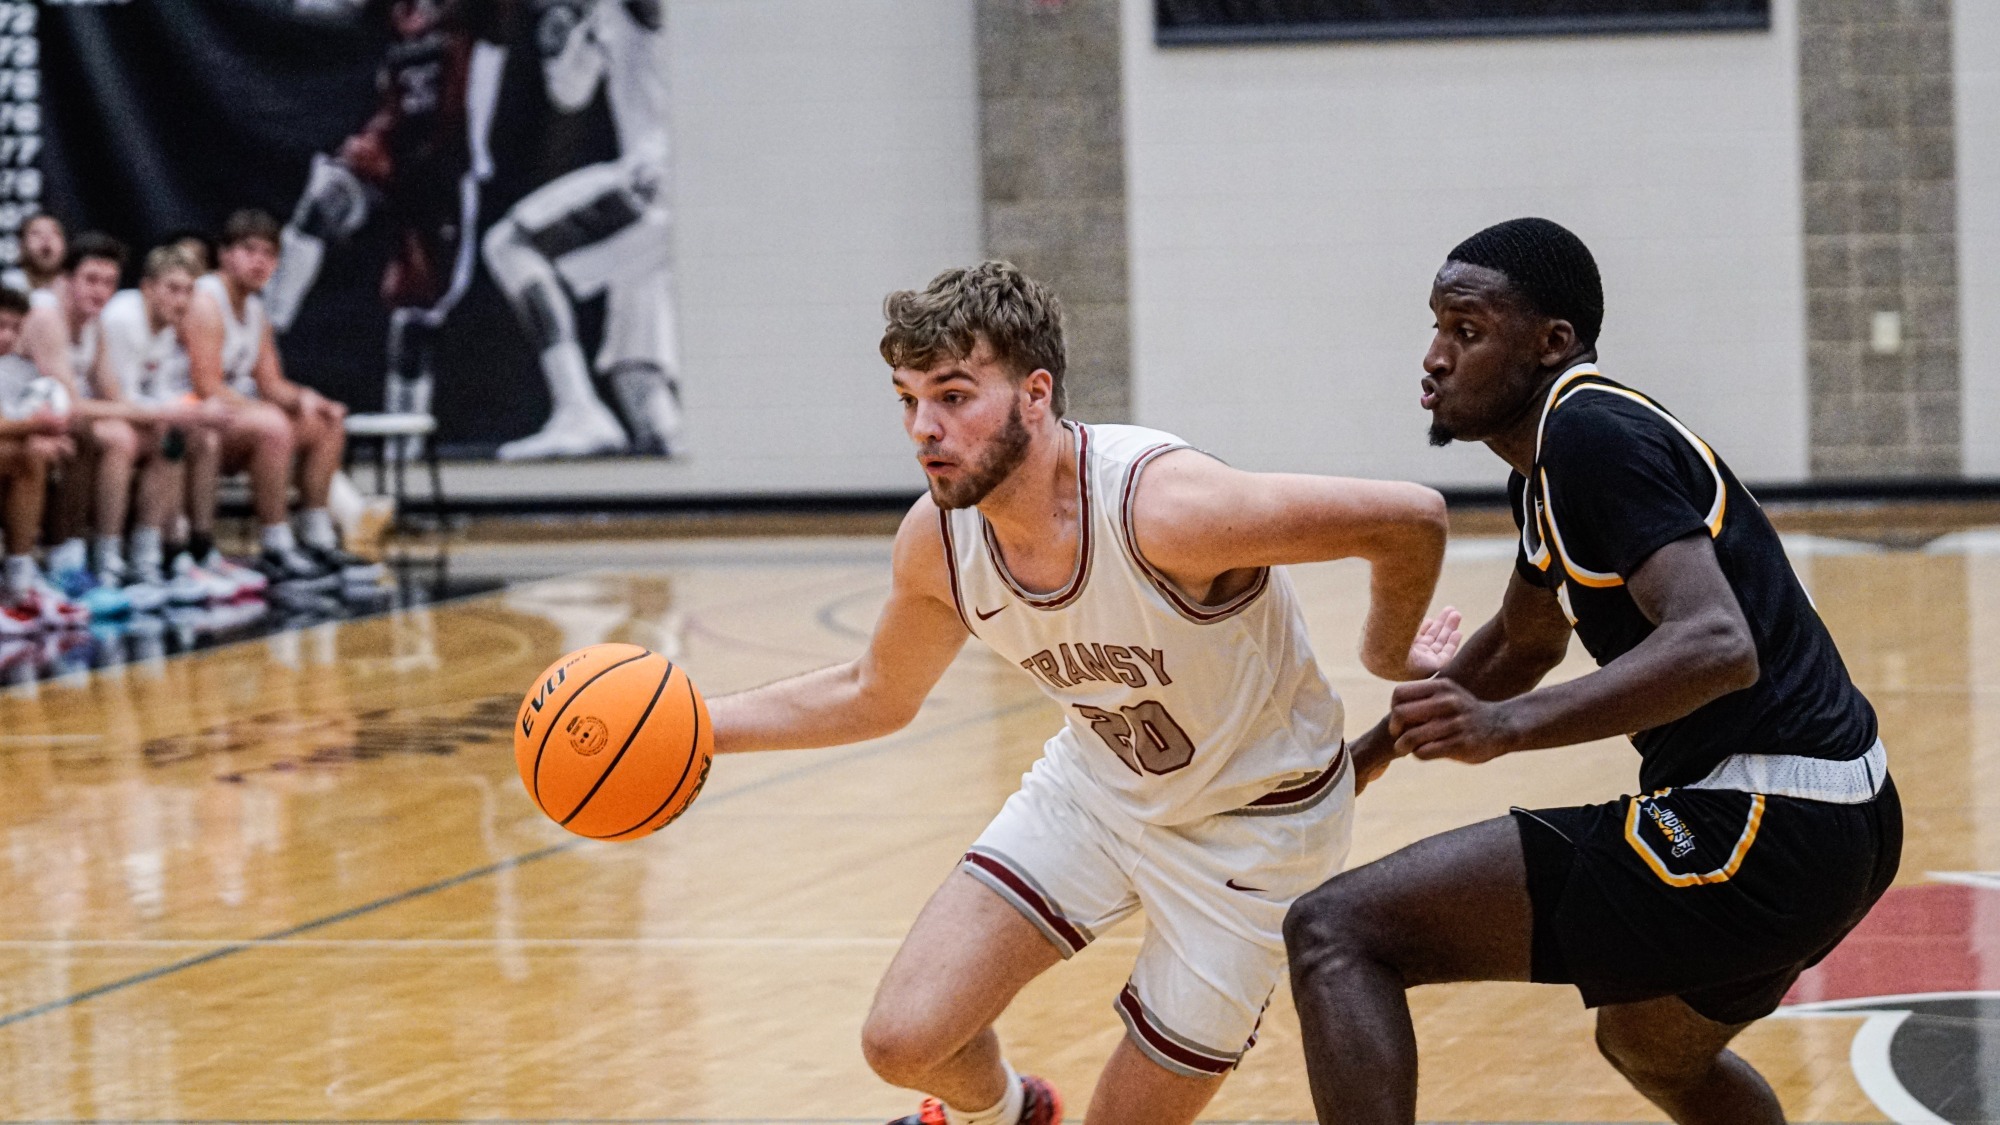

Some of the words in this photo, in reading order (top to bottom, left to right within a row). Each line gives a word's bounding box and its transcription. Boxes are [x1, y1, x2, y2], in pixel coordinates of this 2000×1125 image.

[522, 665, 567, 739] EVO
[1020, 642, 1173, 688] TRANSY
[1071, 699, 1196, 777] 20
